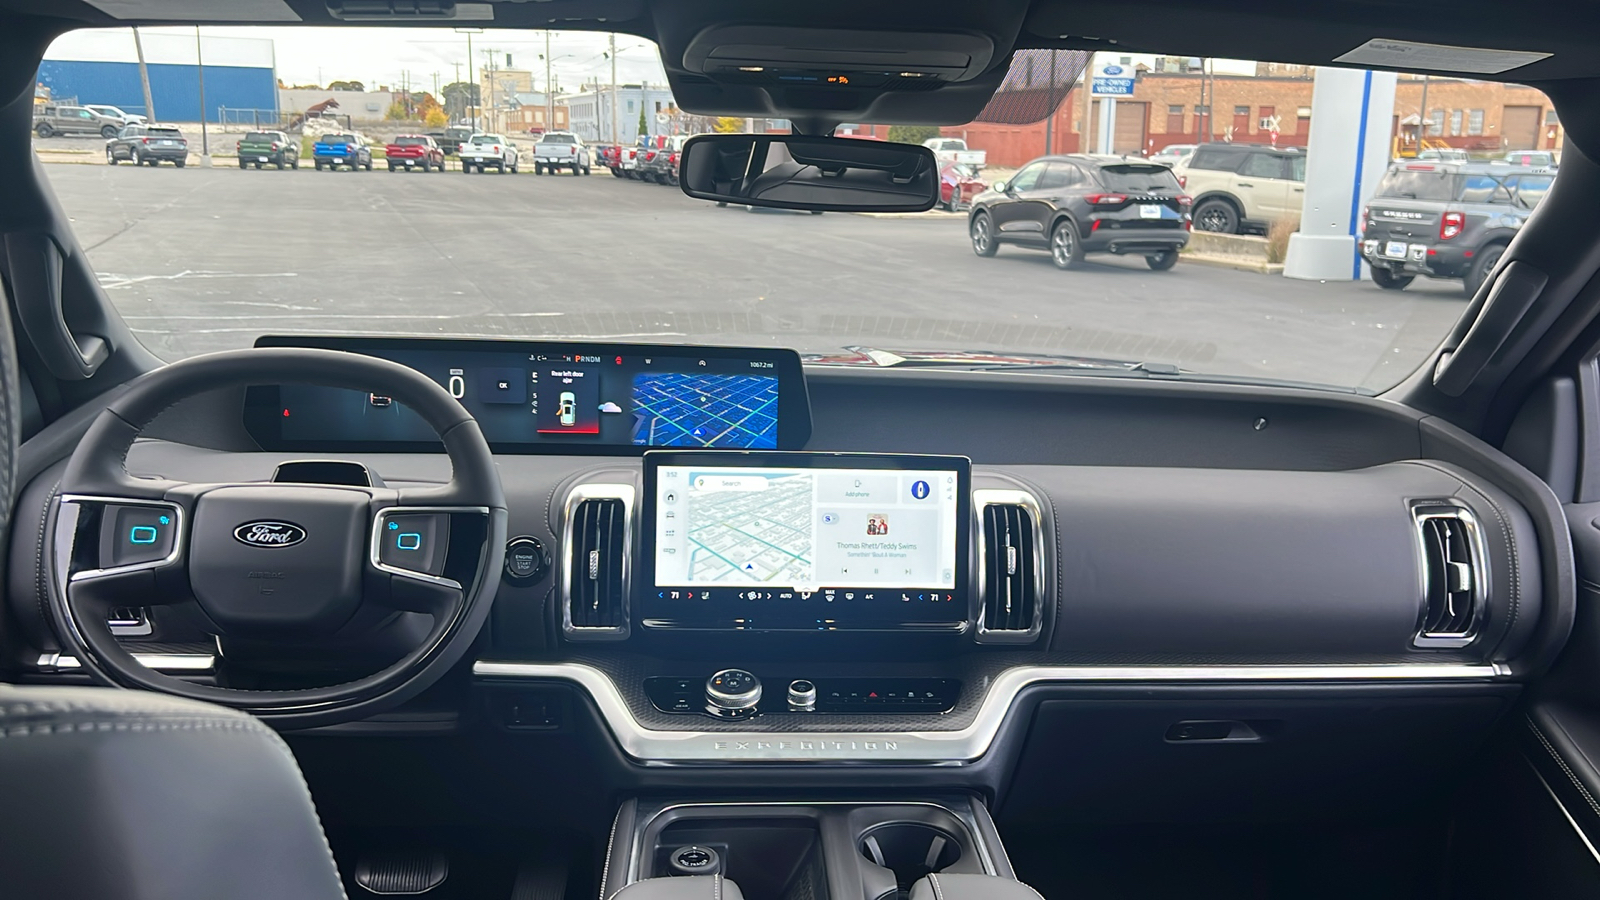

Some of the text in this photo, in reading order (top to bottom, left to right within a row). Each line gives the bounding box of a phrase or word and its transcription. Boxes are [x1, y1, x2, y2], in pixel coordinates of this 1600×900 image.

[1093, 79, 1131, 87] PRE-OWNED
[1096, 86, 1127, 94] VEHICLES
[449, 376, 465, 399] 0
[246, 524, 293, 543] Ford
[861, 542, 897, 551] Rhett/Teddy
[670, 591, 679, 599] 71
[930, 593, 939, 601] 71
[714, 741, 898, 750] EXPEDITION
